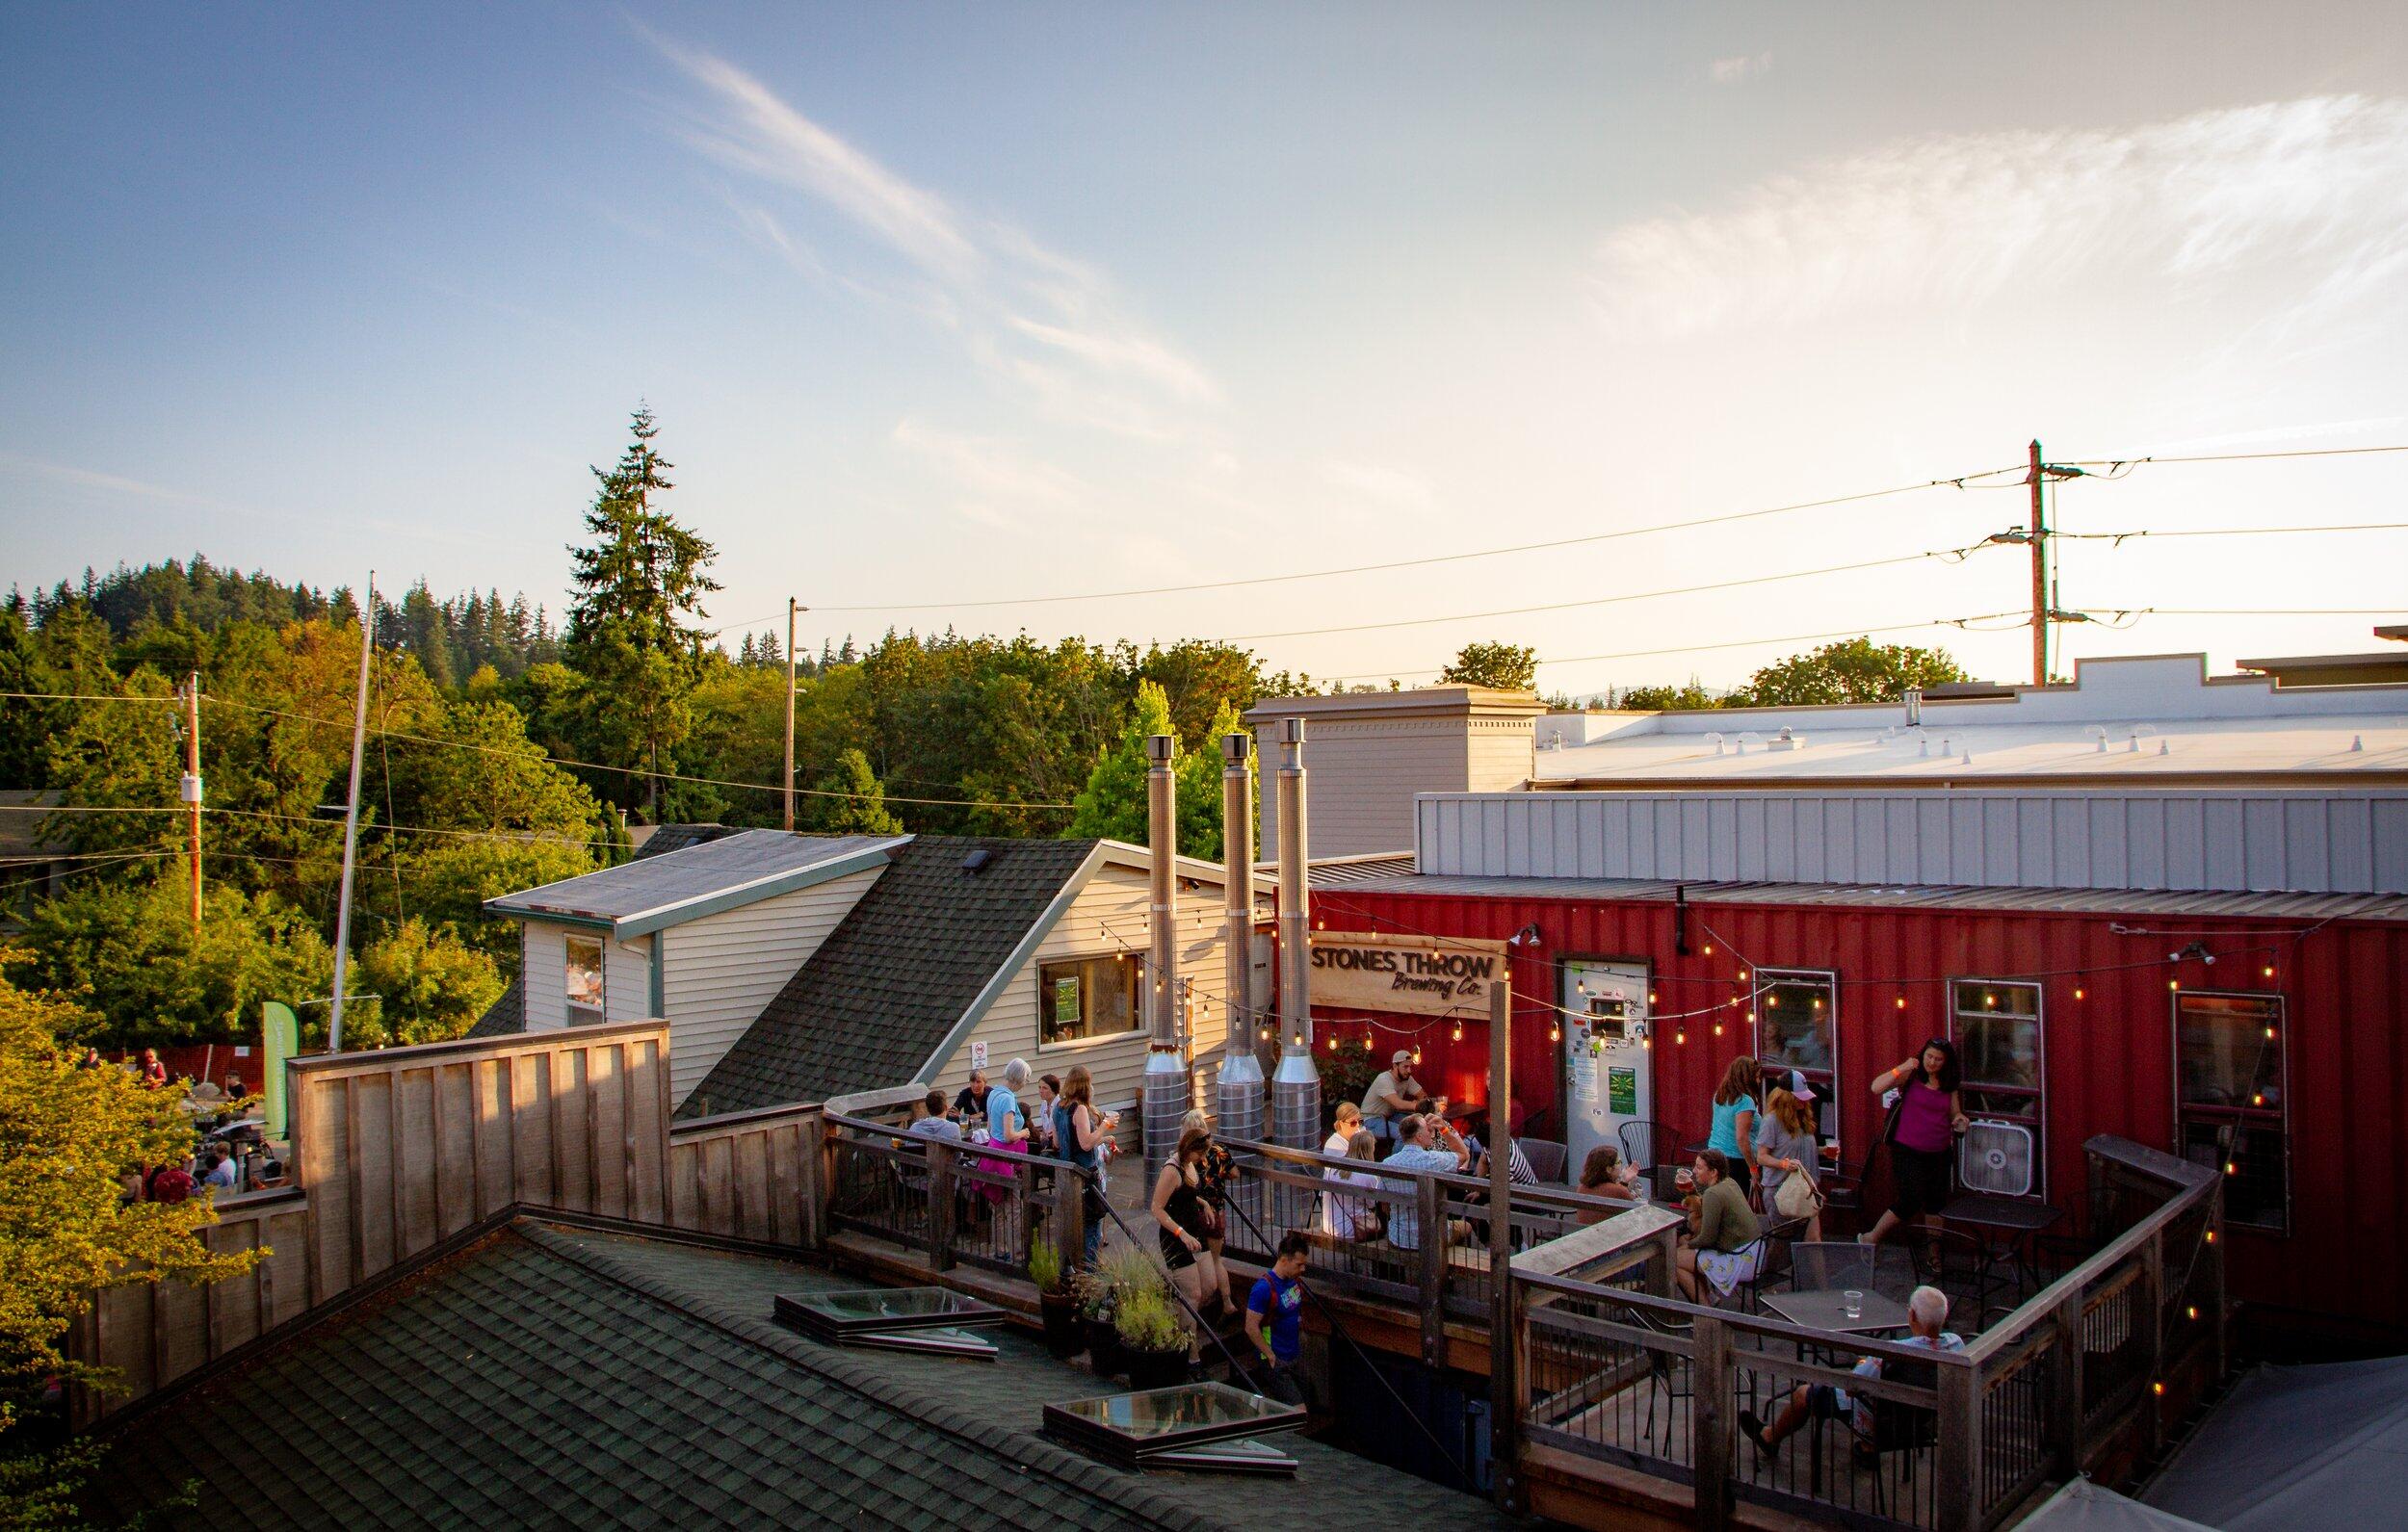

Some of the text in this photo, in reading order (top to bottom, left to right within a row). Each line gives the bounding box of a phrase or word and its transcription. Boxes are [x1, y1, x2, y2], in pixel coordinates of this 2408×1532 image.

[1311, 947, 1493, 978] STONES THROW
[1392, 971, 1482, 1000] Brewing Co.
